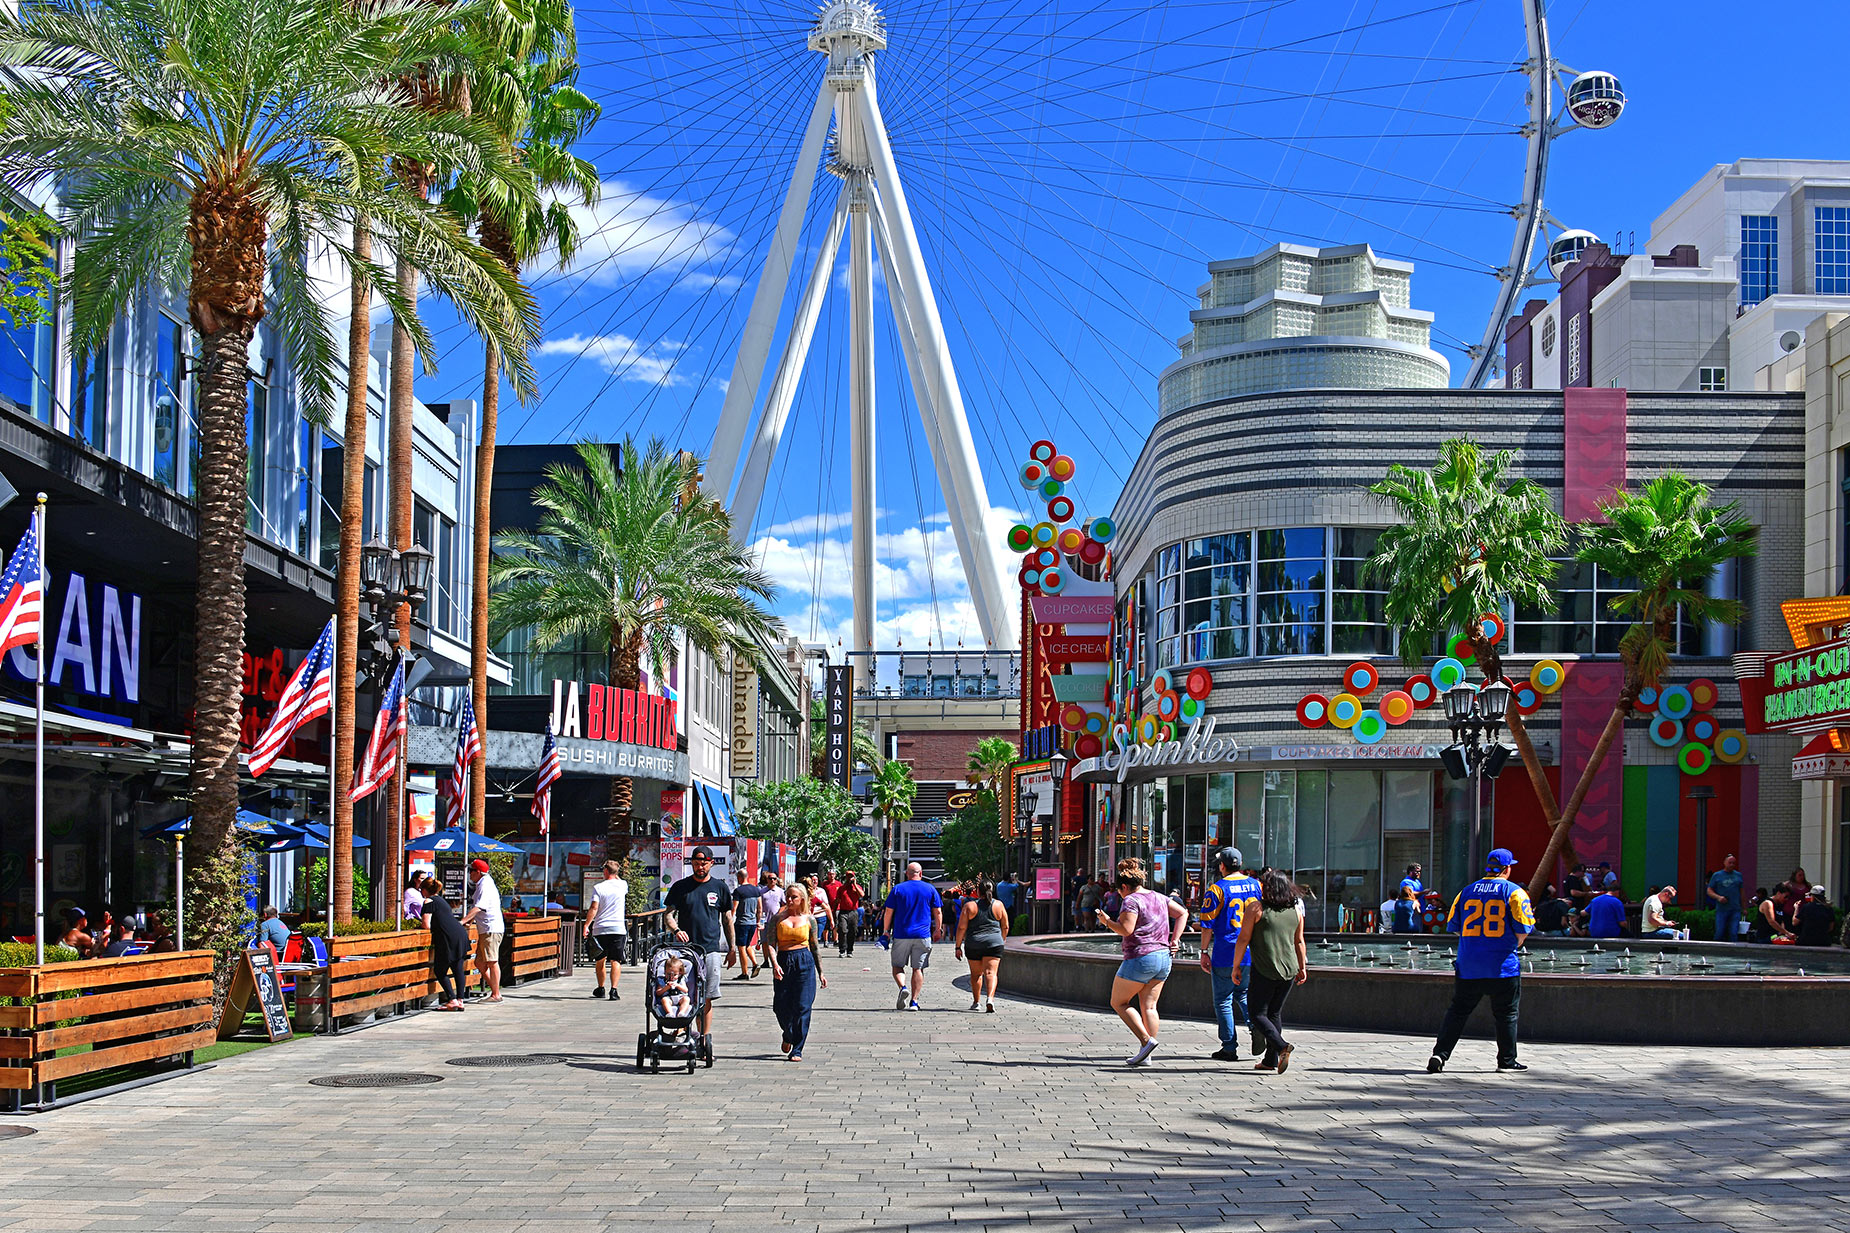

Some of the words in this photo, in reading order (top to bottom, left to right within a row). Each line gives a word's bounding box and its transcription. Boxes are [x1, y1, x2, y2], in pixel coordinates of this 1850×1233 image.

[1578, 105, 1596, 116] HIGH
[1043, 603, 1113, 615] CUPCAKES
[1050, 643, 1068, 654] ICE
[1774, 648, 1850, 688] IN-N-OUT
[1058, 682, 1103, 693] COOKIE
[833, 669, 843, 726] YARD
[551, 678, 581, 738] JA
[587, 683, 678, 751] BURRITOS
[1104, 716, 1240, 783] Sprinkles
[1278, 746, 1351, 758] CUPCAKES
[1356, 745, 1377, 757] ICE
[1378, 745, 1423, 757] CREAM
[557, 747, 612, 765] SUSHI
[618, 752, 674, 772] BURRITOS
[832, 734, 843, 786] HOUS
[662, 796, 683, 804] SUSHI
[661, 852, 683, 861] POPS
[1473, 883, 1500, 893] FAULK
[1462, 899, 1506, 938] 28
